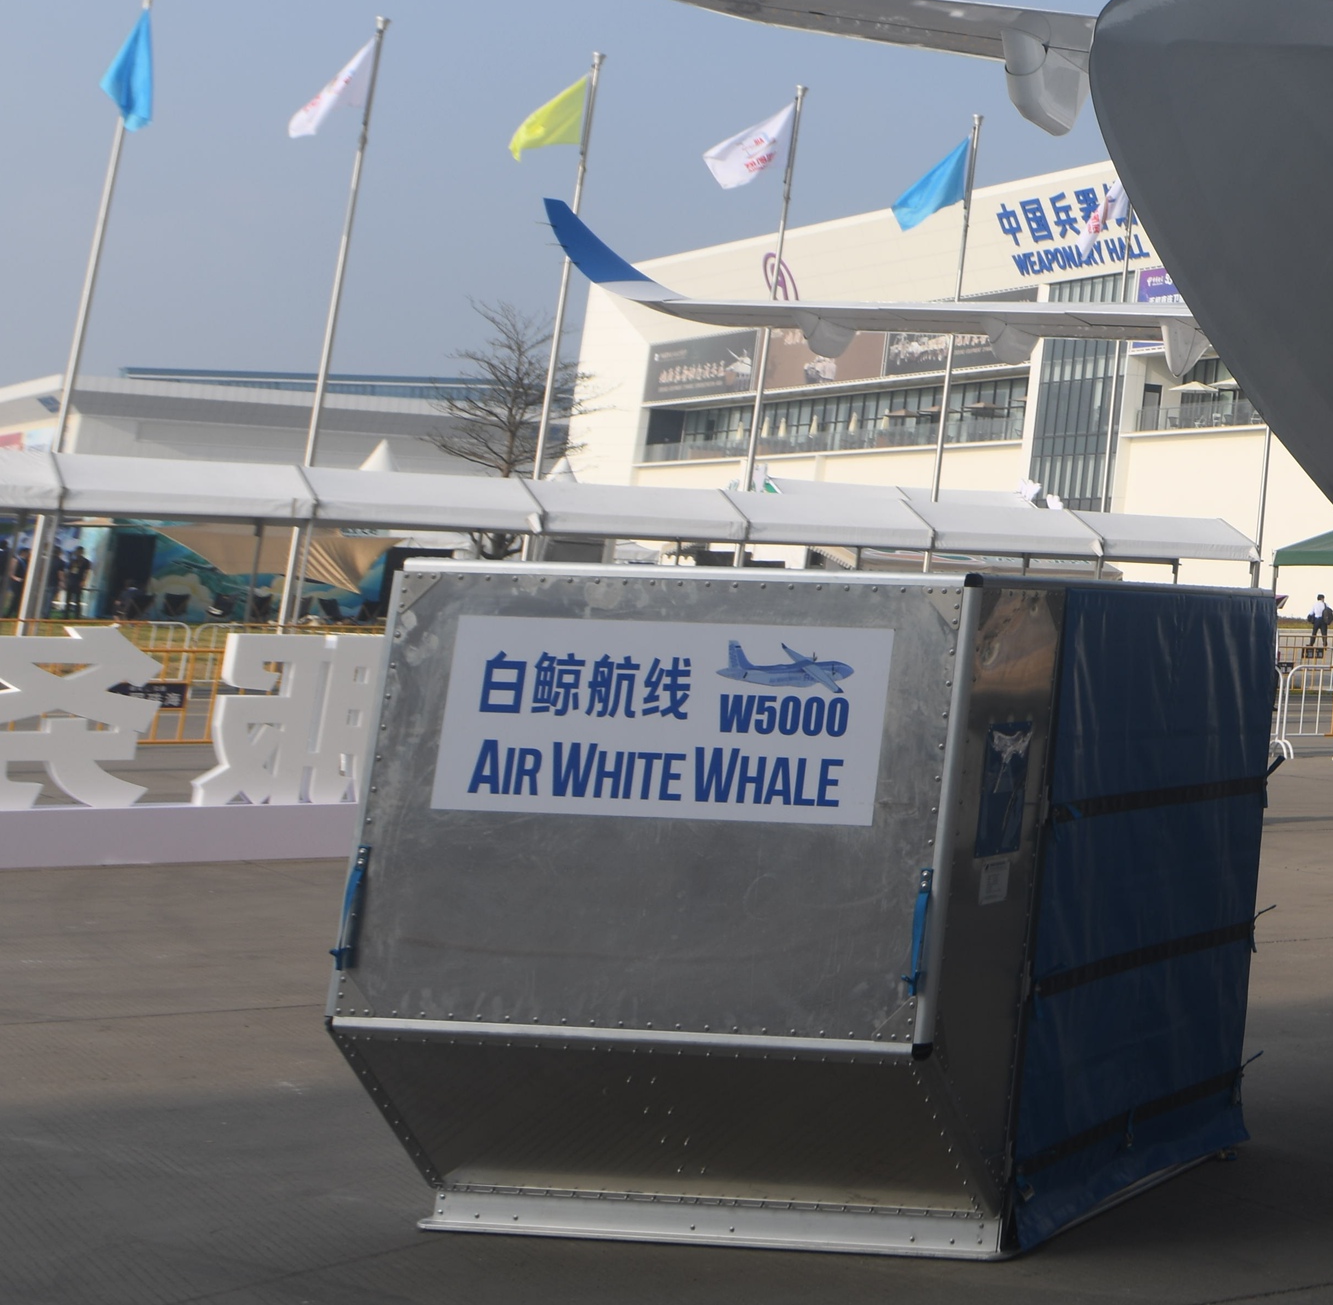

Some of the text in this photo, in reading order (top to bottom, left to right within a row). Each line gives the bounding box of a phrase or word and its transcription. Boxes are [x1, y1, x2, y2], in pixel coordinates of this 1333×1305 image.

[1104, 233, 1150, 263] HALL
[479, 650, 692, 720] 白鲸航线
[720, 694, 849, 737] W5000
[467, 739, 844, 807] AIR WHITE WHALE
